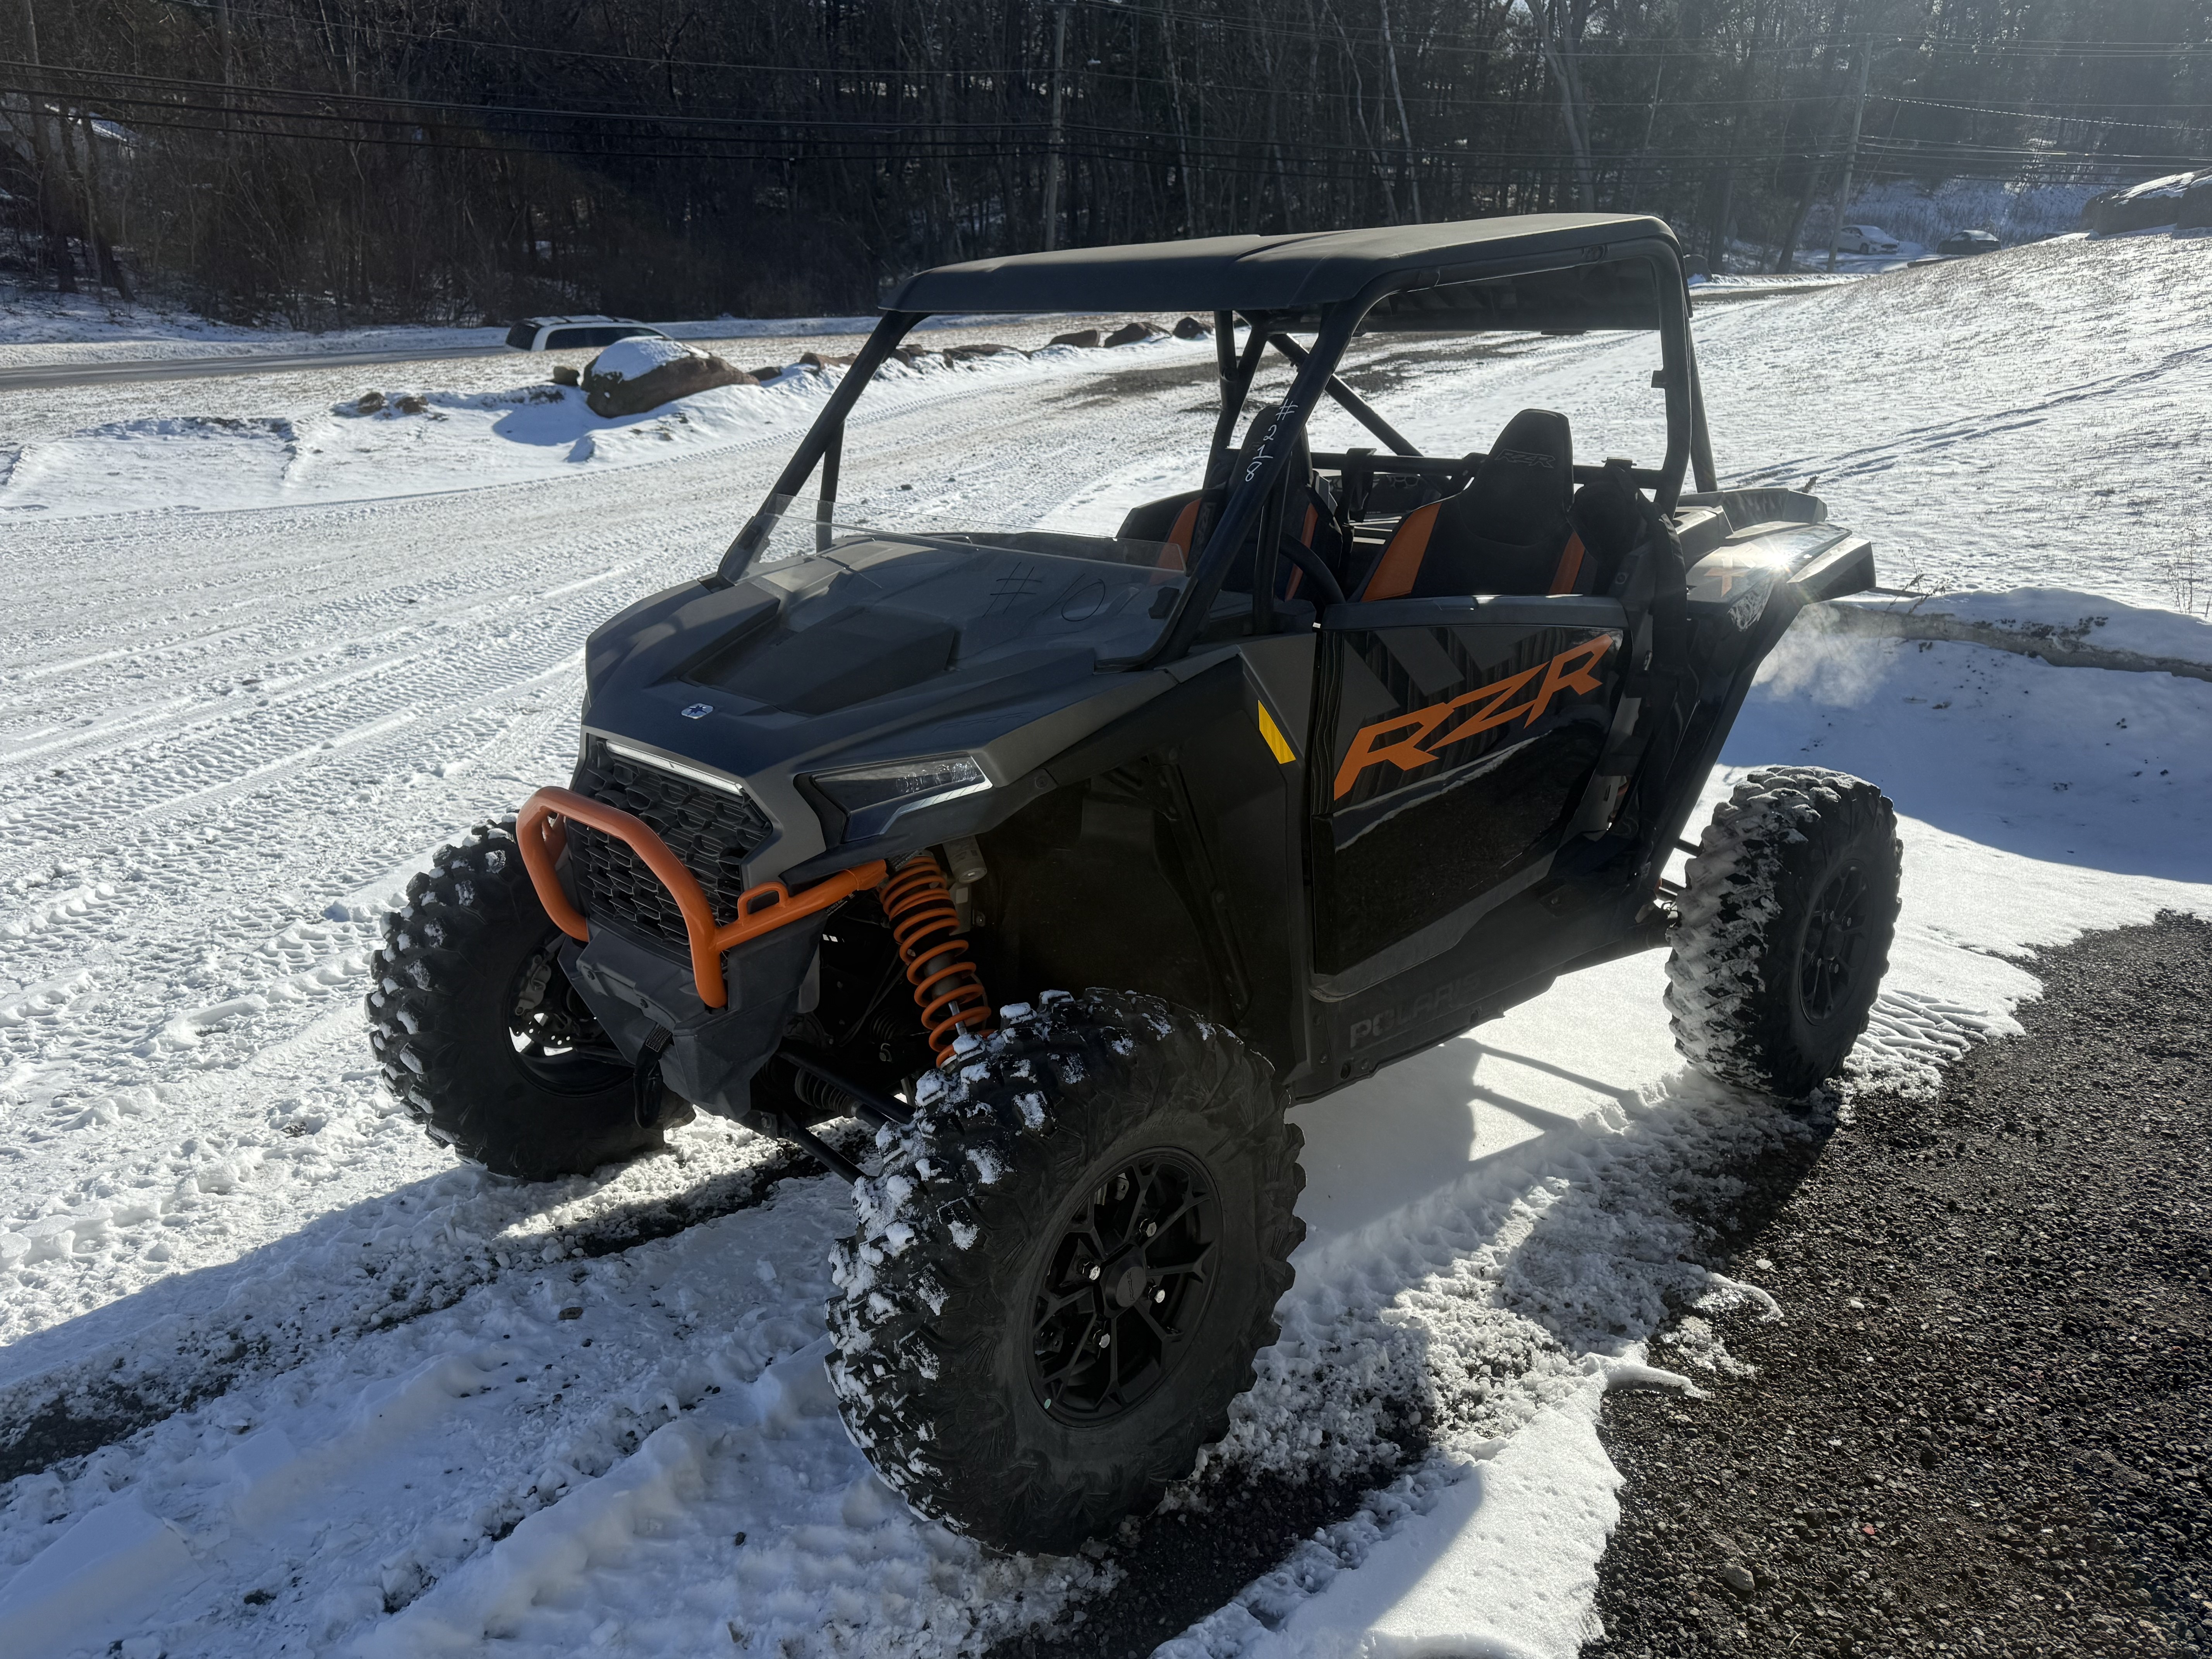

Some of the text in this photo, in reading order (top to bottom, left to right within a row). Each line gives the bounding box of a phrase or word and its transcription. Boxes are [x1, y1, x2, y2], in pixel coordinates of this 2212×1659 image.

[1244, 398, 1299, 483] #218
[1494, 448, 1556, 469] RZR
[1334, 633, 1613, 800] RZR
[1350, 973, 1482, 1049] POLARIS
